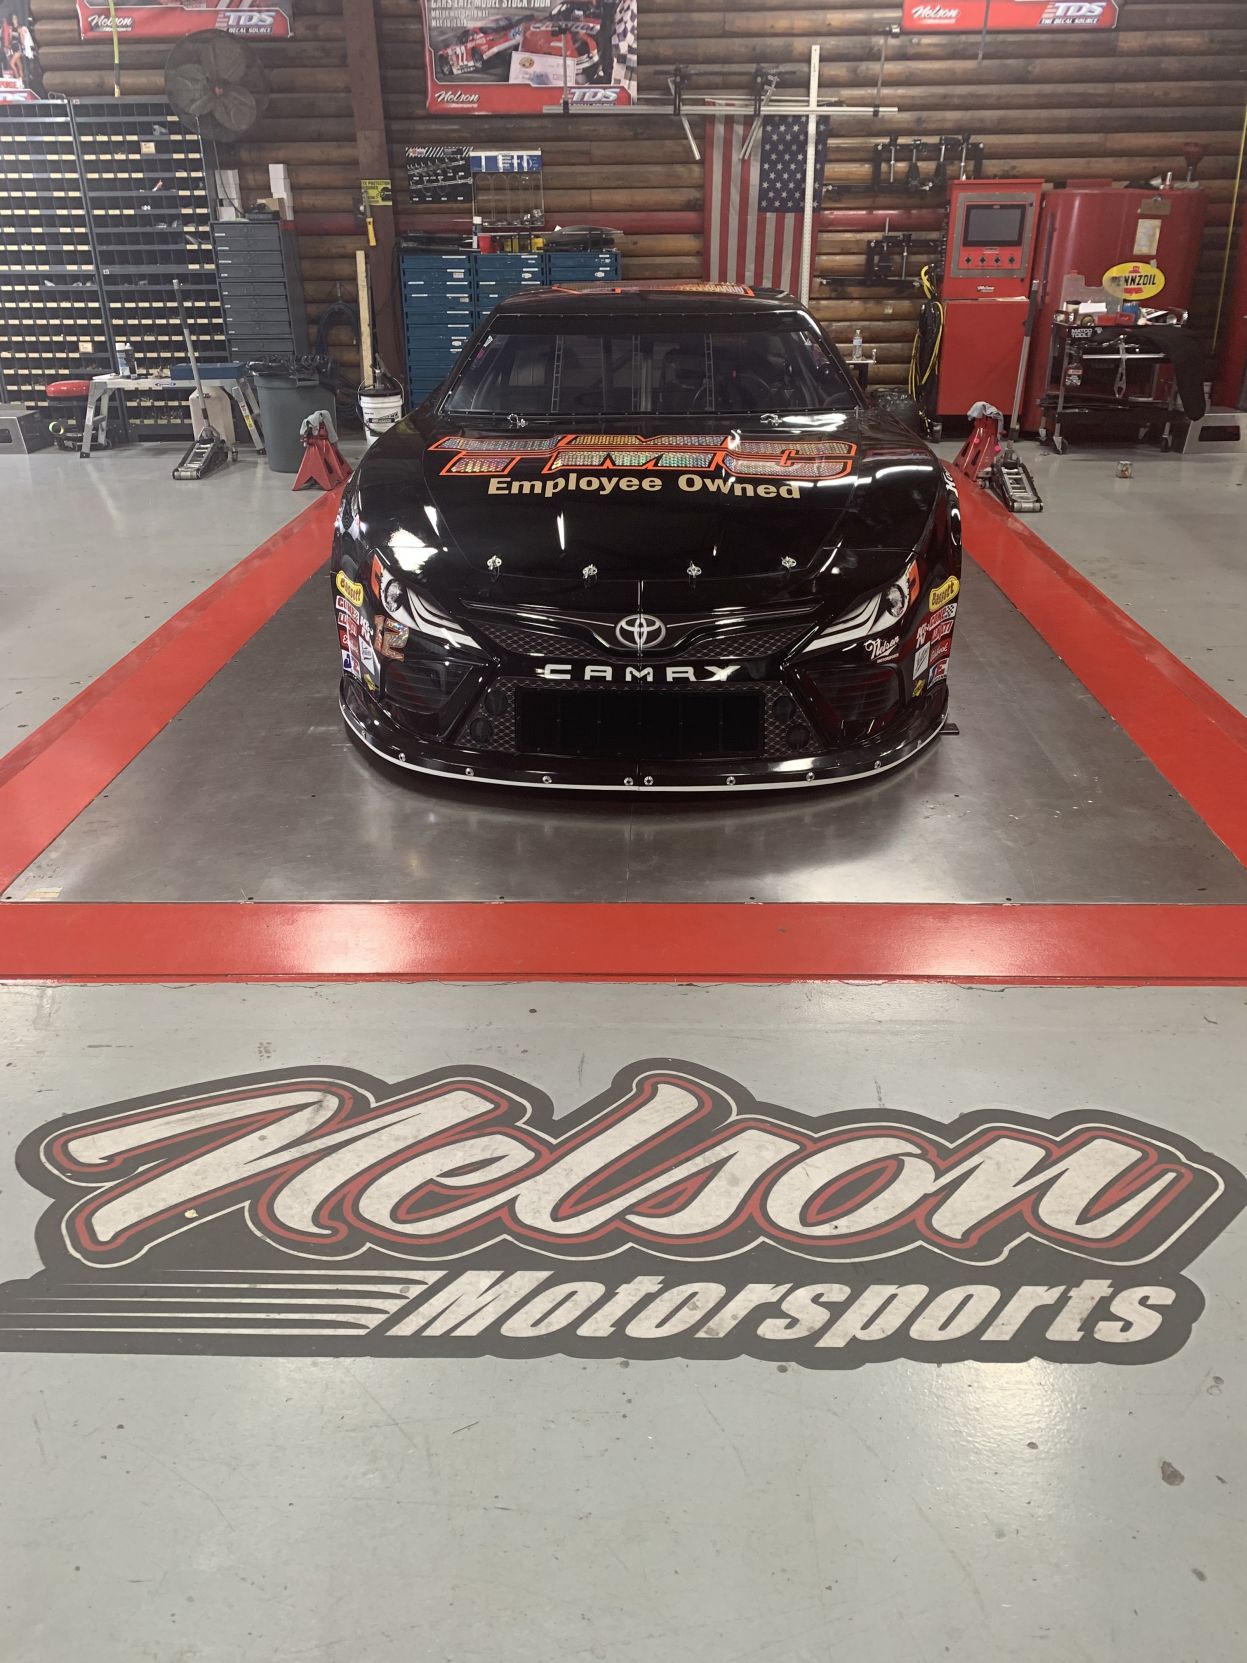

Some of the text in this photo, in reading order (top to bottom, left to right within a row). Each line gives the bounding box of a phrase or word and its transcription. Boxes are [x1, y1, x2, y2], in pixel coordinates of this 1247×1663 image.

[502, 0, 528, 8] STOCK
[530, 0, 551, 8] TOUR
[1055, 2, 1106, 16] TDS
[912, 5, 959, 18] Nelson
[225, 12, 275, 25] TDS
[435, 90, 480, 102] Nelson
[571, 88, 620, 101] TDS
[1110, 274, 1156, 286] NNZOIL
[487, 472, 801, 499] Employee Owned
[52, 1076, 1193, 1252] Nelson
[385, 1270, 1176, 1348] Motorsports
